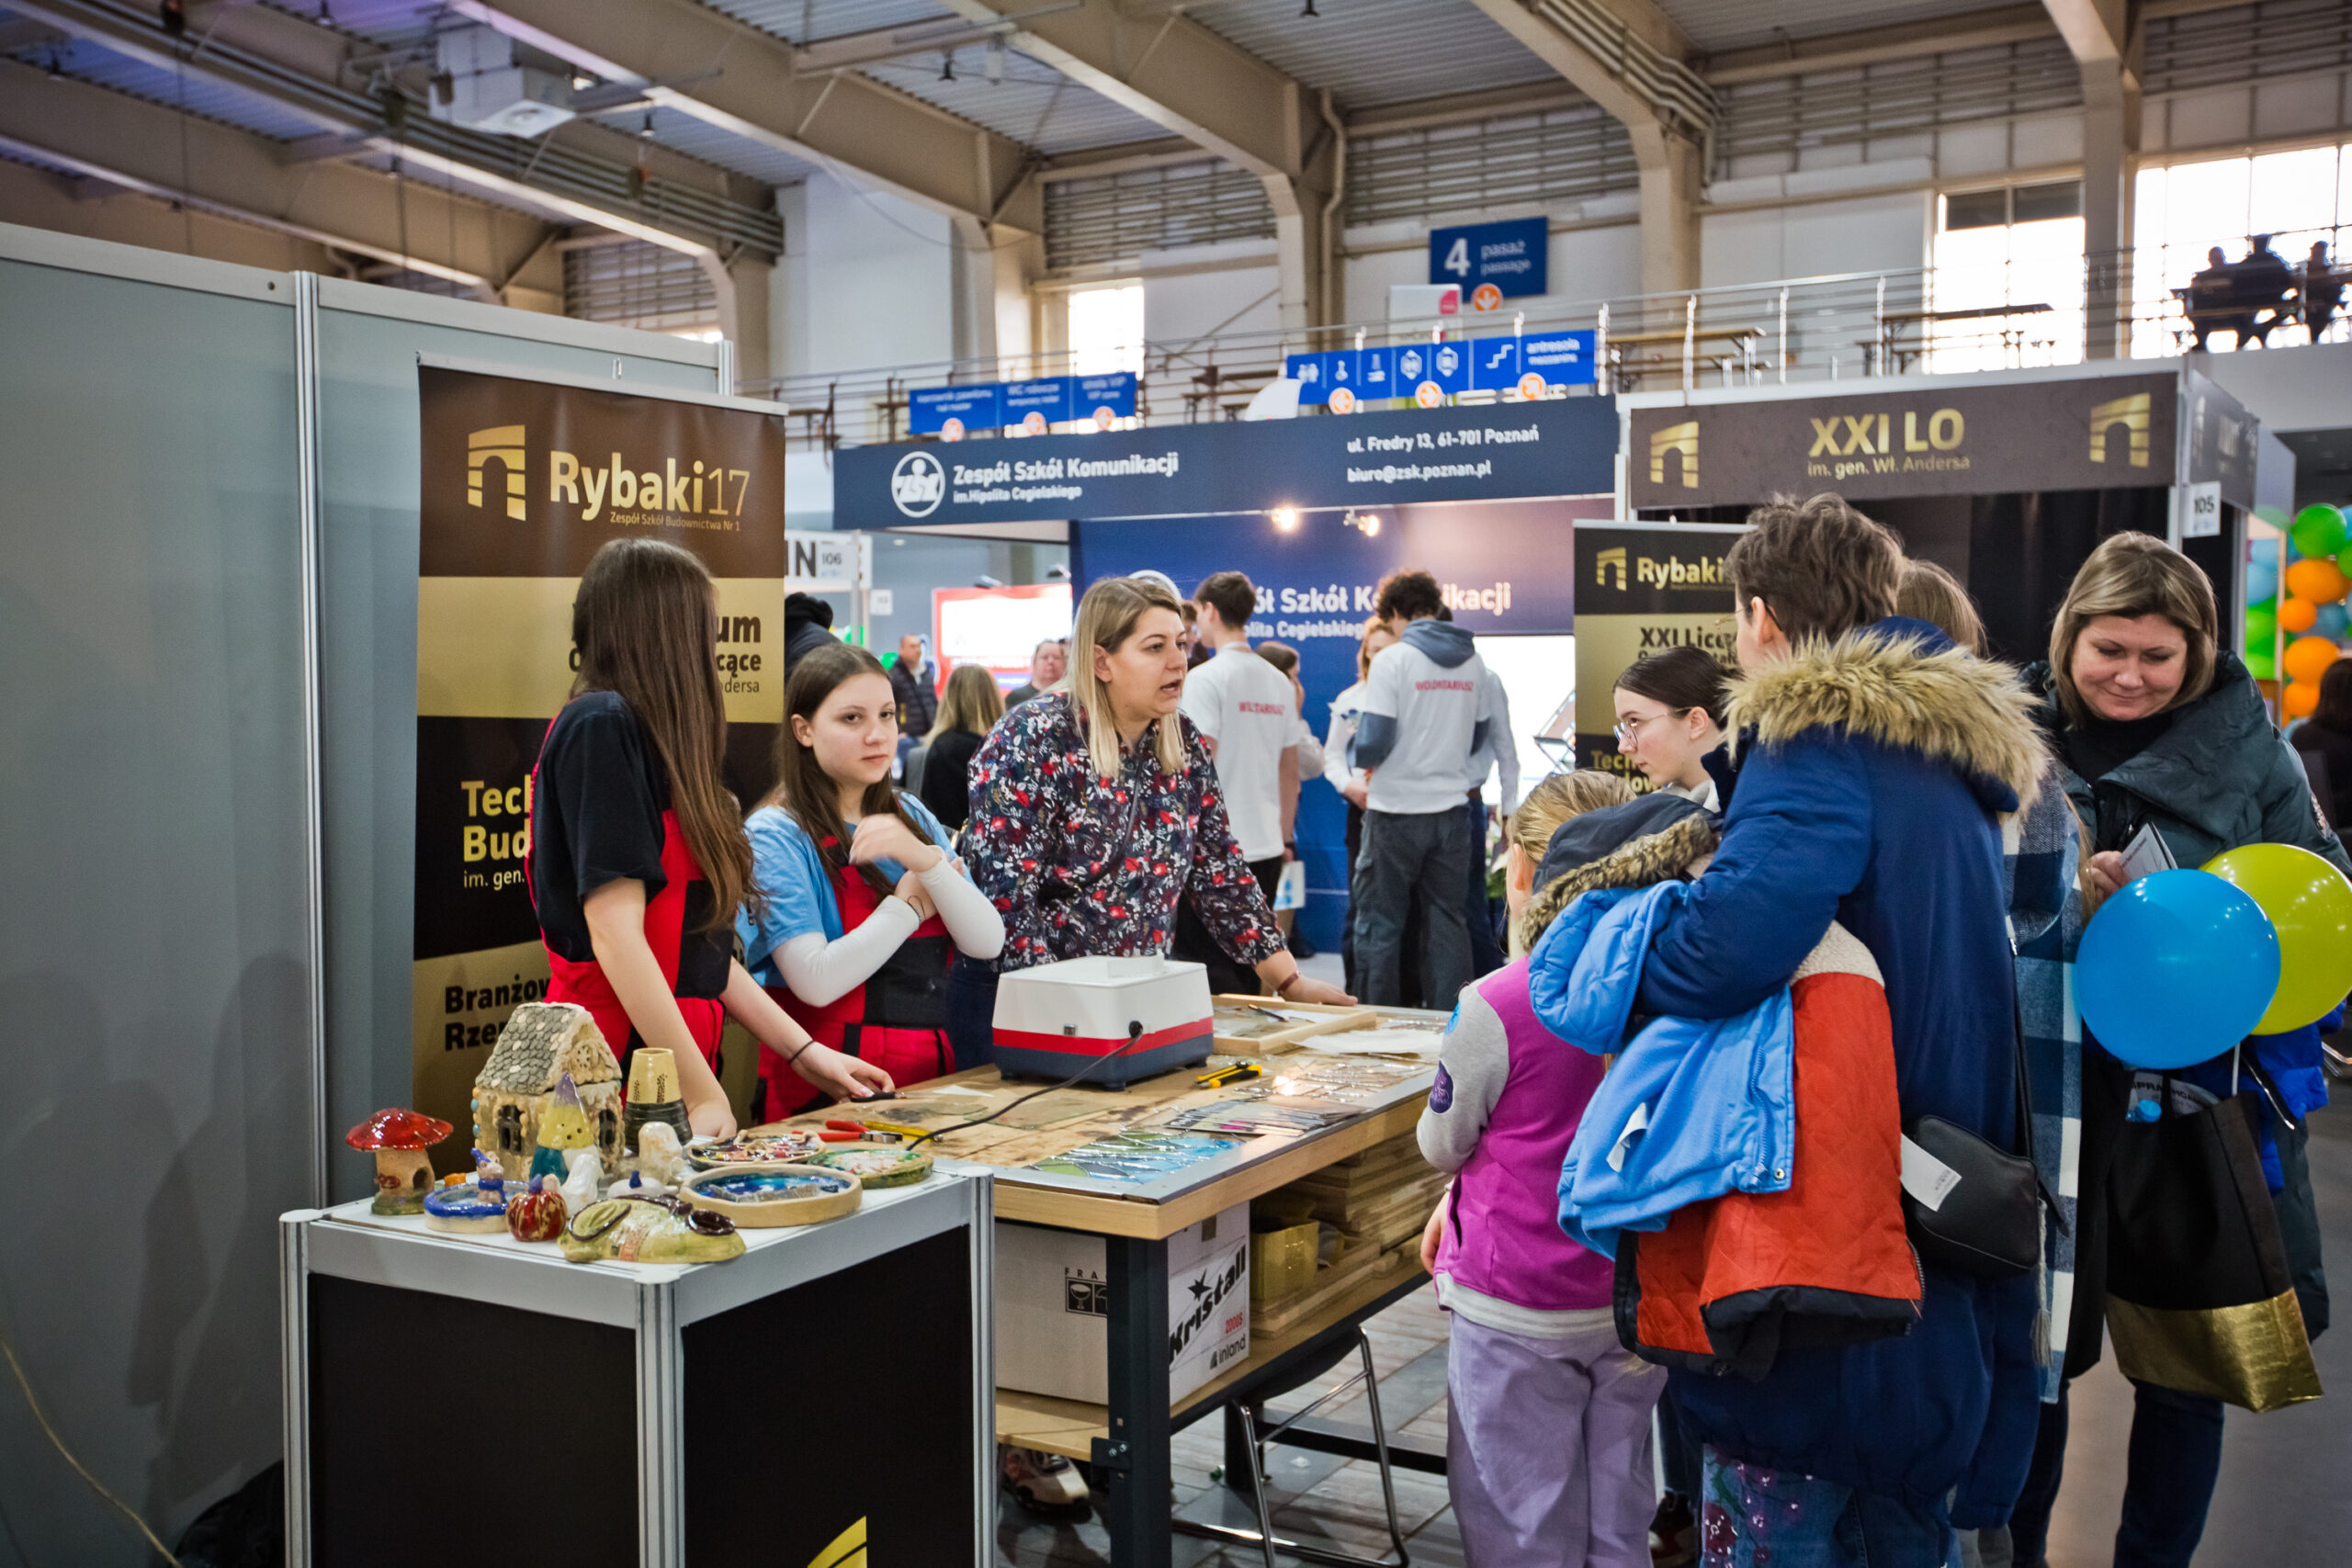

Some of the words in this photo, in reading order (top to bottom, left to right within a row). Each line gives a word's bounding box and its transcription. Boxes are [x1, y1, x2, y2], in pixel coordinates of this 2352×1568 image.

[1444, 237, 1470, 276] 4
[1347, 437, 1364, 453] ul.
[1367, 434, 1414, 453] Fredry
[1416, 432, 1435, 450] 13,
[1437, 429, 1482, 447] 61-701
[1485, 423, 1540, 445] Poznań
[1808, 413, 1890, 457] XXI
[1905, 408, 1964, 452] LO
[953, 460, 1012, 488] Zespół
[1014, 457, 1064, 481] Szkół
[1068, 452, 1179, 478] Komunikacji
[1347, 459, 1493, 484] biuro@zsk.poznan.pl
[1808, 462, 1832, 479] im.
[1835, 461, 1870, 481] gen.
[1903, 454, 1971, 473] Andersa
[550, 450, 751, 522] Rybaki17
[1012, 483, 1083, 502] Cegielskiego
[2193, 494, 2215, 514] 105
[610, 511, 640, 526] Zespół
[641, 513, 664, 526] Szkół
[665, 516, 721, 531] Budownictwa
[723, 520, 734, 531] Nr
[735, 521, 741, 531] 1
[821, 552, 842, 566] 106
[1280, 583, 1349, 614] Szkół
[1640, 627, 1679, 648] XXI
[463, 871, 489, 889] im.
[493, 870, 526, 891] gen.
[1169, 1244, 1246, 1366] Kristall
[1219, 1332, 1246, 1364] inland
